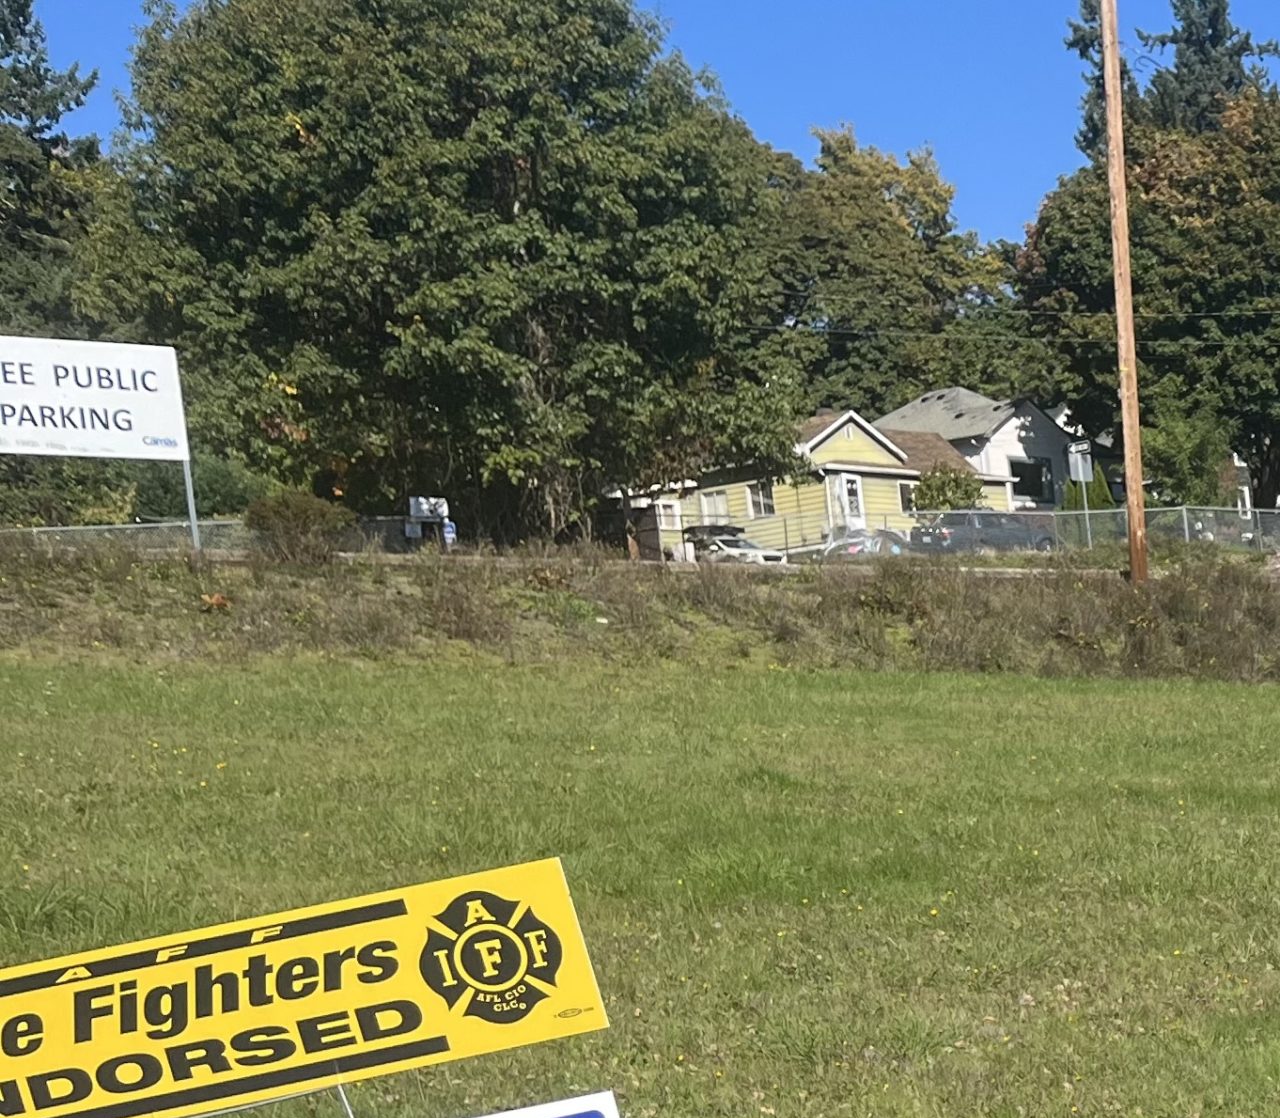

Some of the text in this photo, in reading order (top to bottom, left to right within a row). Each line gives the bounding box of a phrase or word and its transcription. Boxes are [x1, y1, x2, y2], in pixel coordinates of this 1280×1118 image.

[0, 361, 159, 392] EE PUBLIC
[0, 403, 134, 432] PARKING
[73, 940, 400, 1044] Fighters
[476, 984, 527, 1004] AFL CIO
[0, 999, 423, 1117] DORSED
